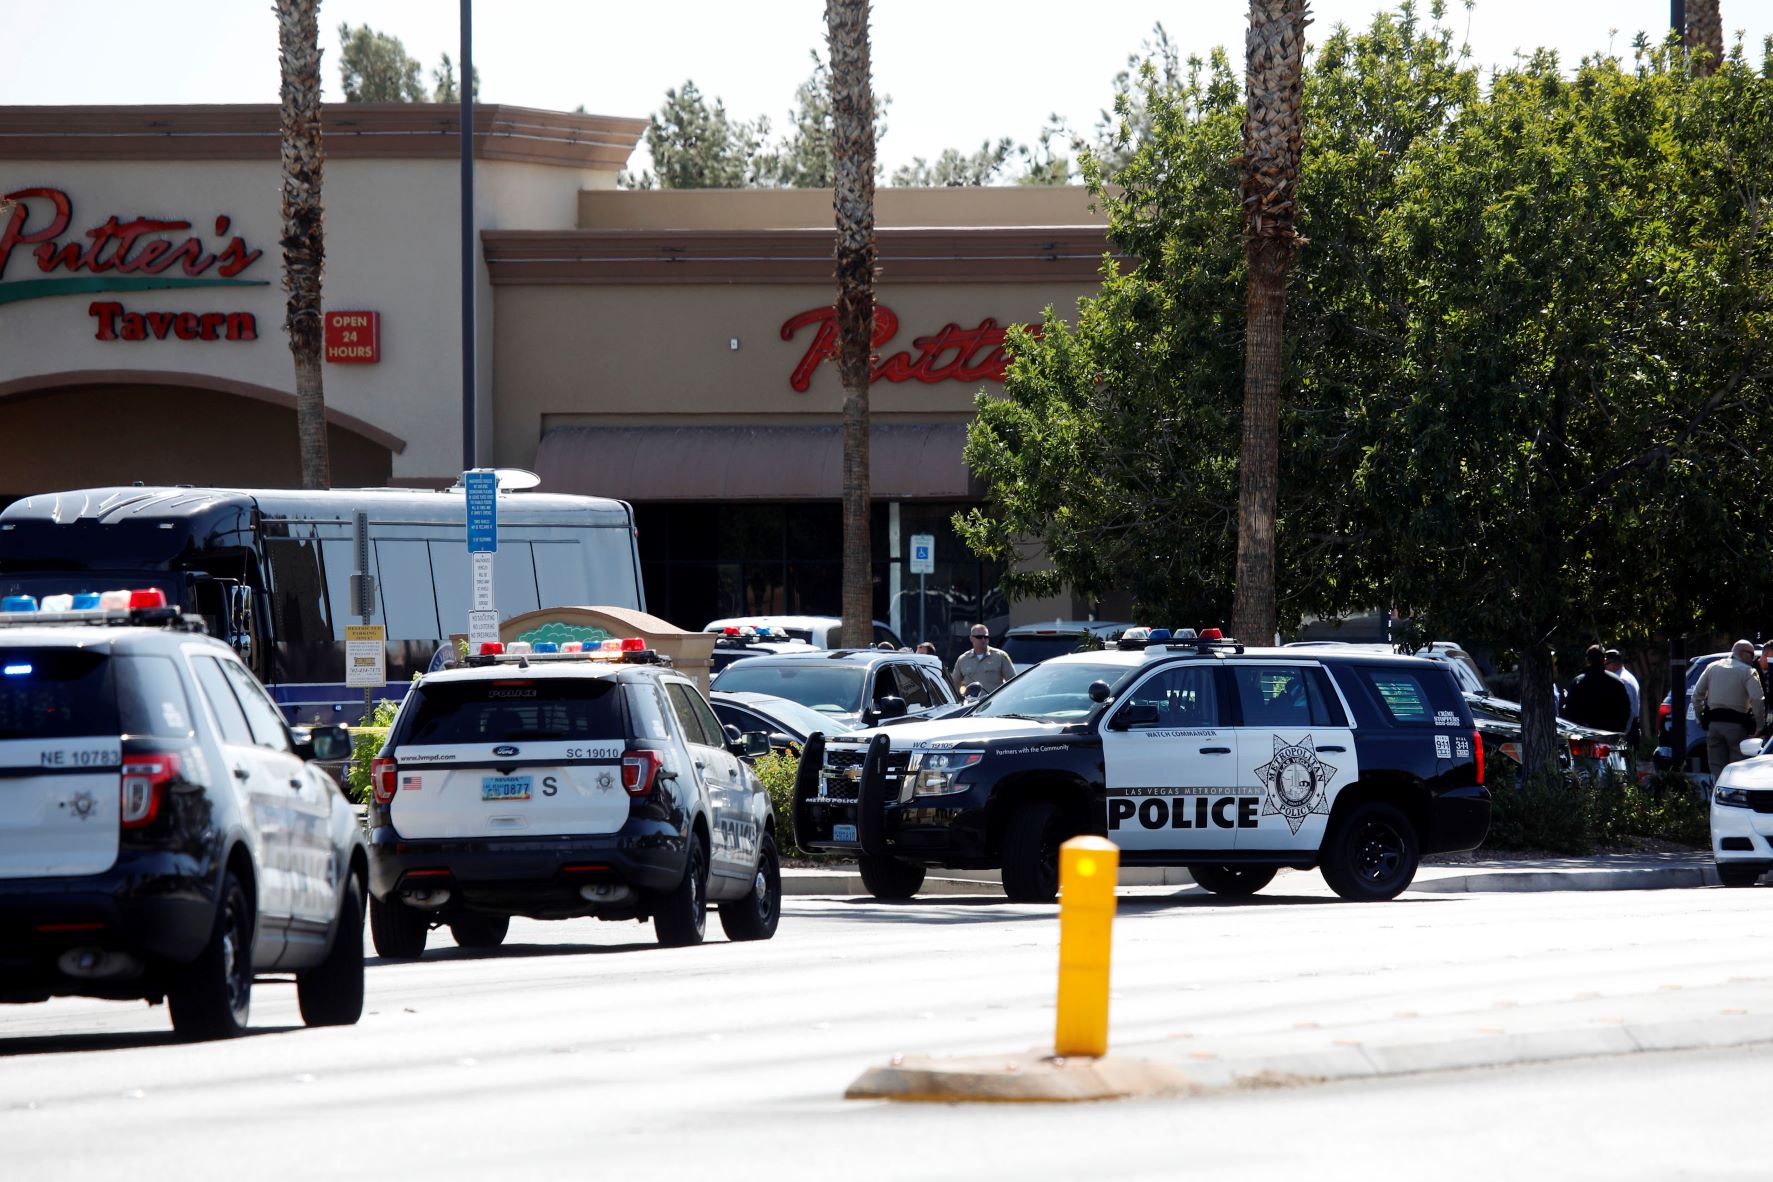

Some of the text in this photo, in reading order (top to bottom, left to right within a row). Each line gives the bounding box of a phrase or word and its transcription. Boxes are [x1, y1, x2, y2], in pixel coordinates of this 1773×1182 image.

[0, 187, 263, 283] Putter's
[89, 302, 258, 341] Tavern
[332, 316, 368, 328] OPEN
[342, 331, 358, 343] 24
[328, 346, 373, 358] HOURS
[488, 689, 537, 698] POLICE
[41, 750, 120, 765] NE 10783
[401, 754, 456, 762] www.lvmpd.com
[566, 748, 619, 758] SC 19010
[1268, 748, 1324, 782] METROPOLITAN
[504, 784, 530, 794] 0877
[543, 776, 558, 797] S
[1108, 796, 1260, 830] POLICE
[1280, 804, 1313, 816] POLICE
